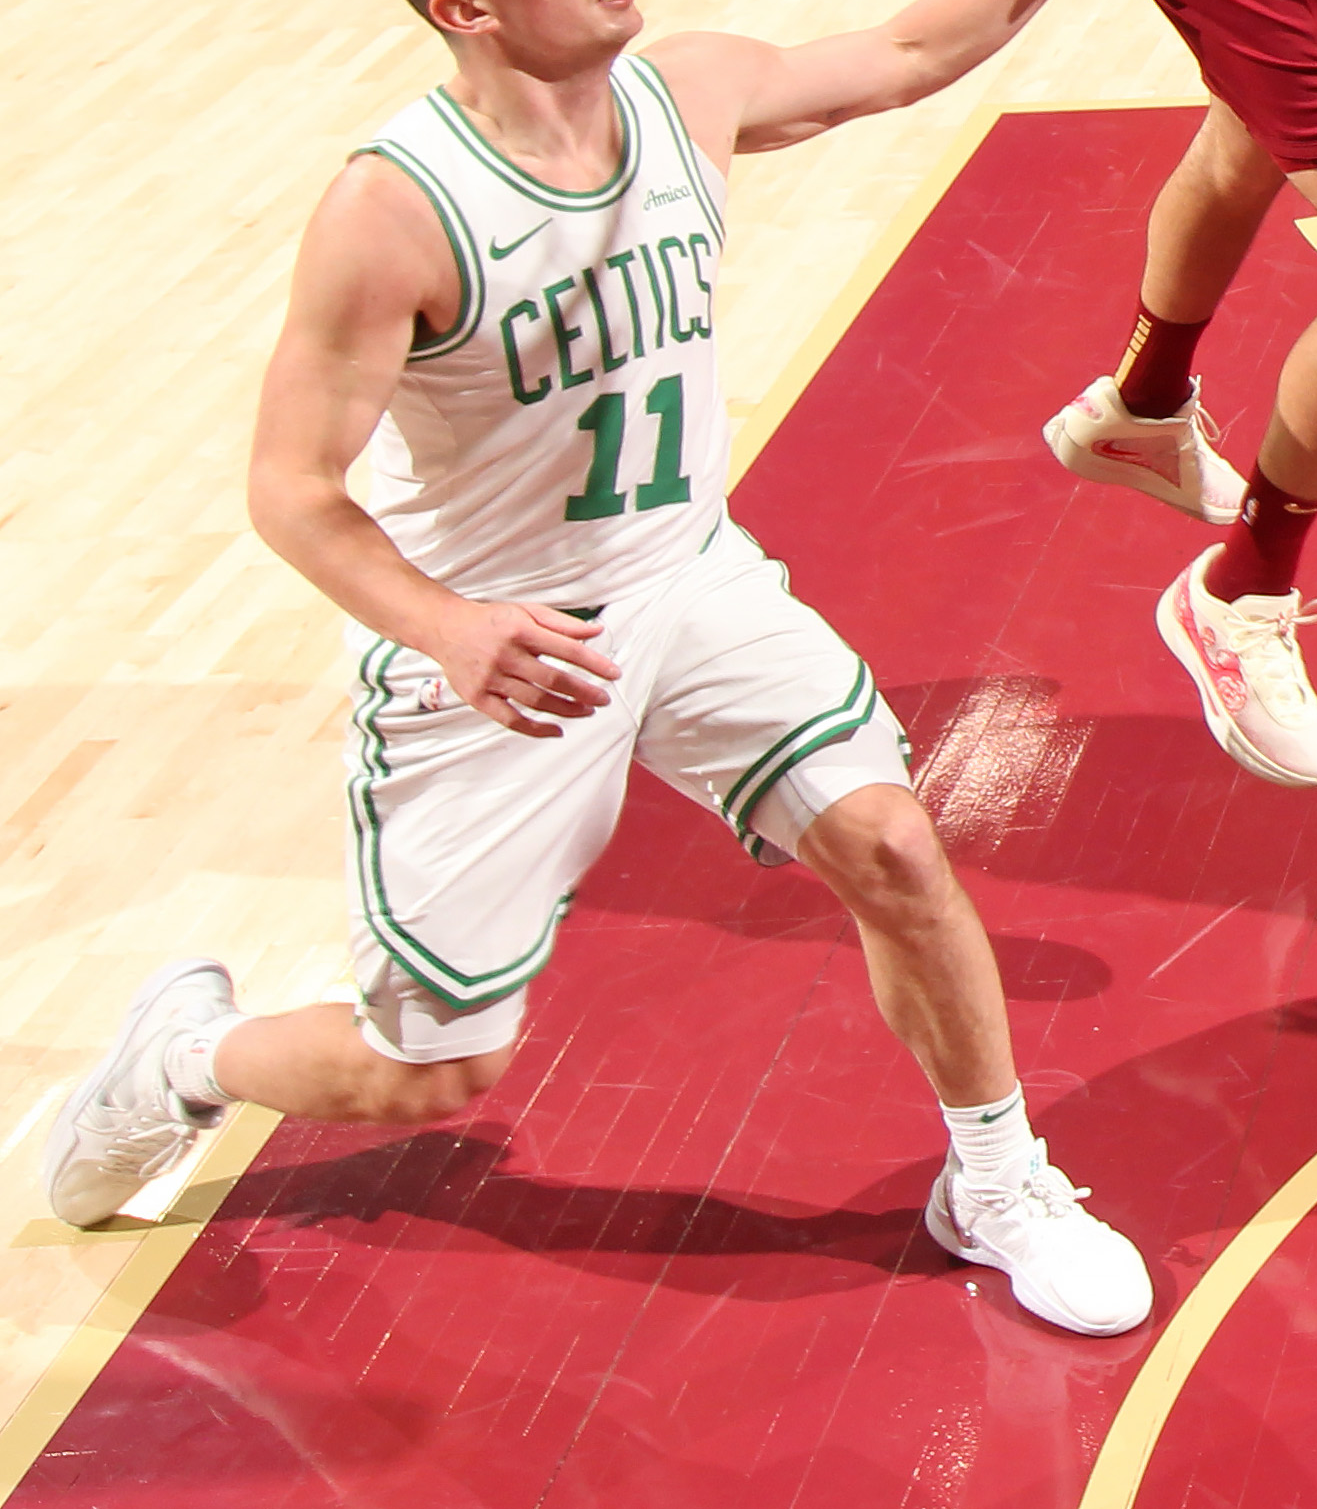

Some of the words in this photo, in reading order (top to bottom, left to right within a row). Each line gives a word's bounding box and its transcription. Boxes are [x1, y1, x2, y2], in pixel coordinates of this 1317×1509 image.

[643, 183, 692, 212] Amica
[500, 232, 714, 406] CELTICS
[564, 372, 693, 522] 11
